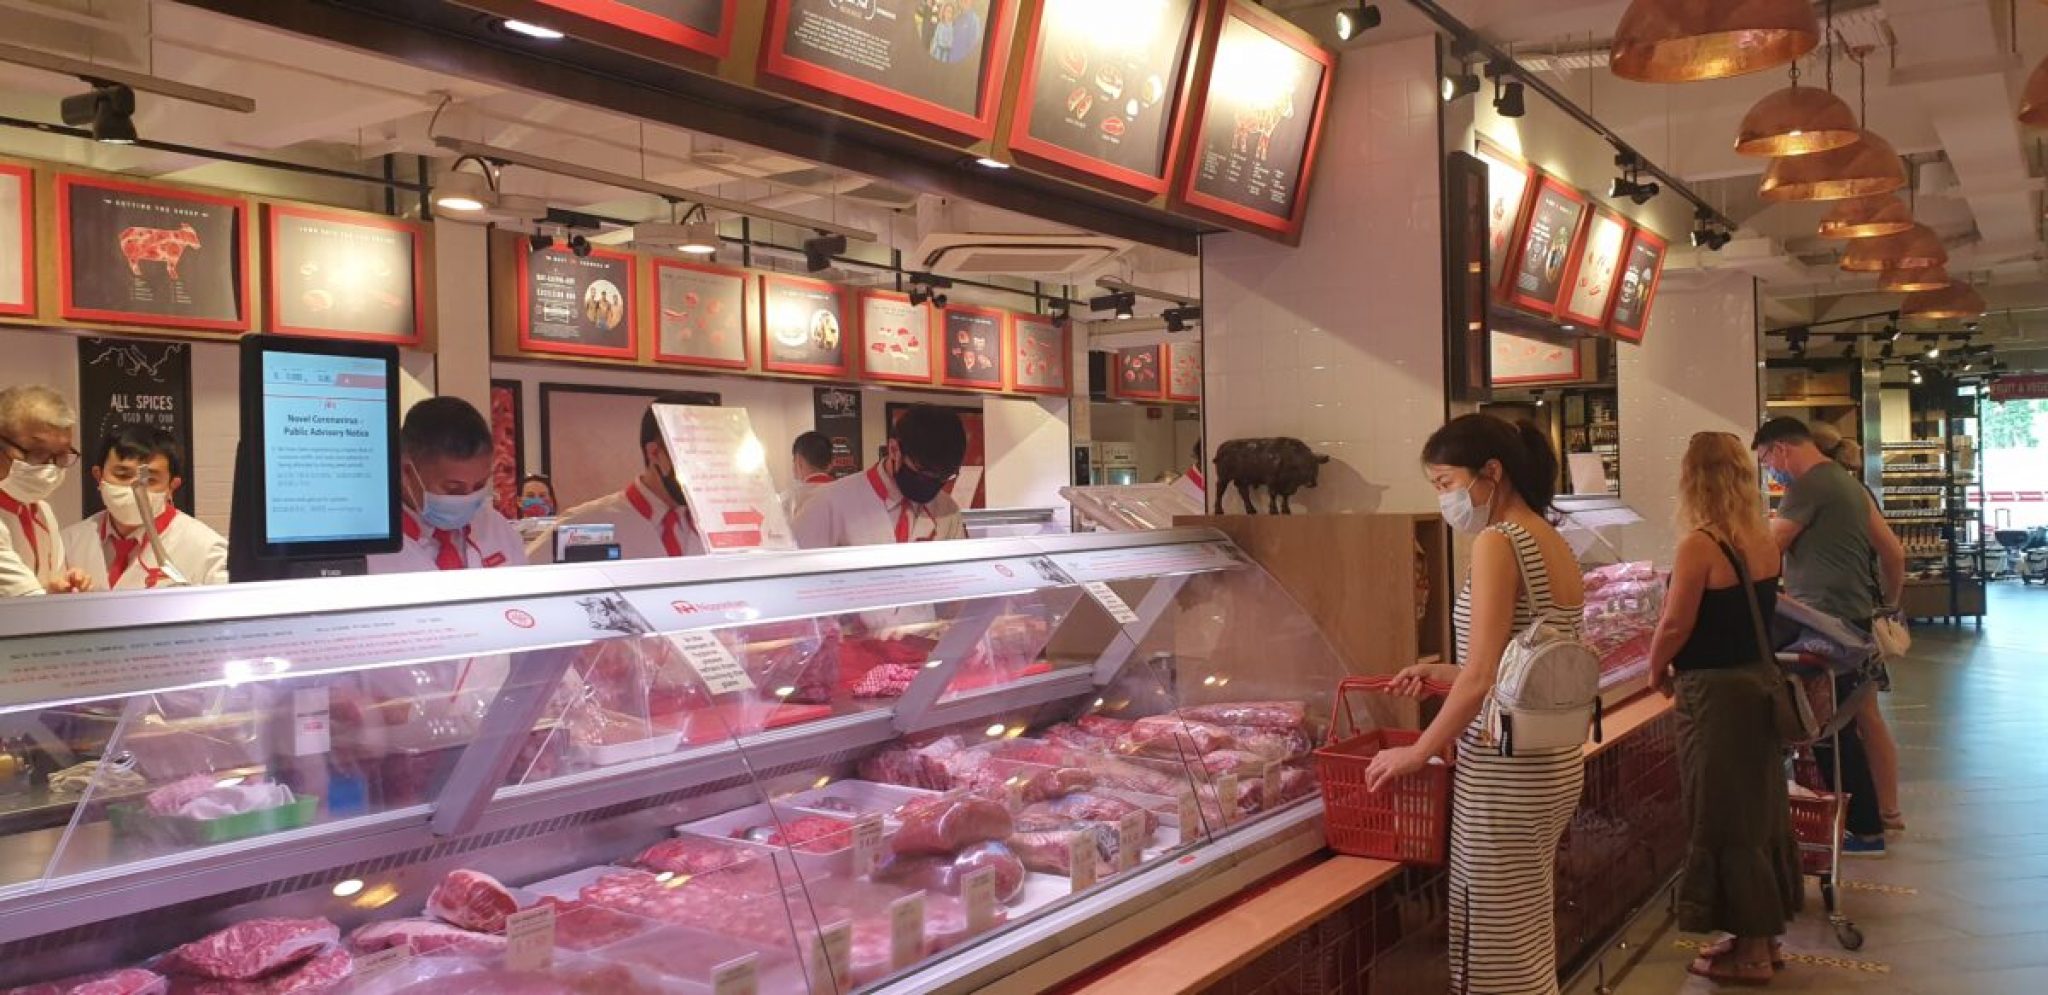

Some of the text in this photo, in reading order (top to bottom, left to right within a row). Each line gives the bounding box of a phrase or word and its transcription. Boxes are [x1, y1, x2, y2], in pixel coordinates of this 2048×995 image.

[110, 393, 174, 412] ALL SPICES
[287, 414, 311, 423] Novel
[312, 414, 358, 424] Coronavirus
[283, 426, 369, 438] Public Advisory Notice
